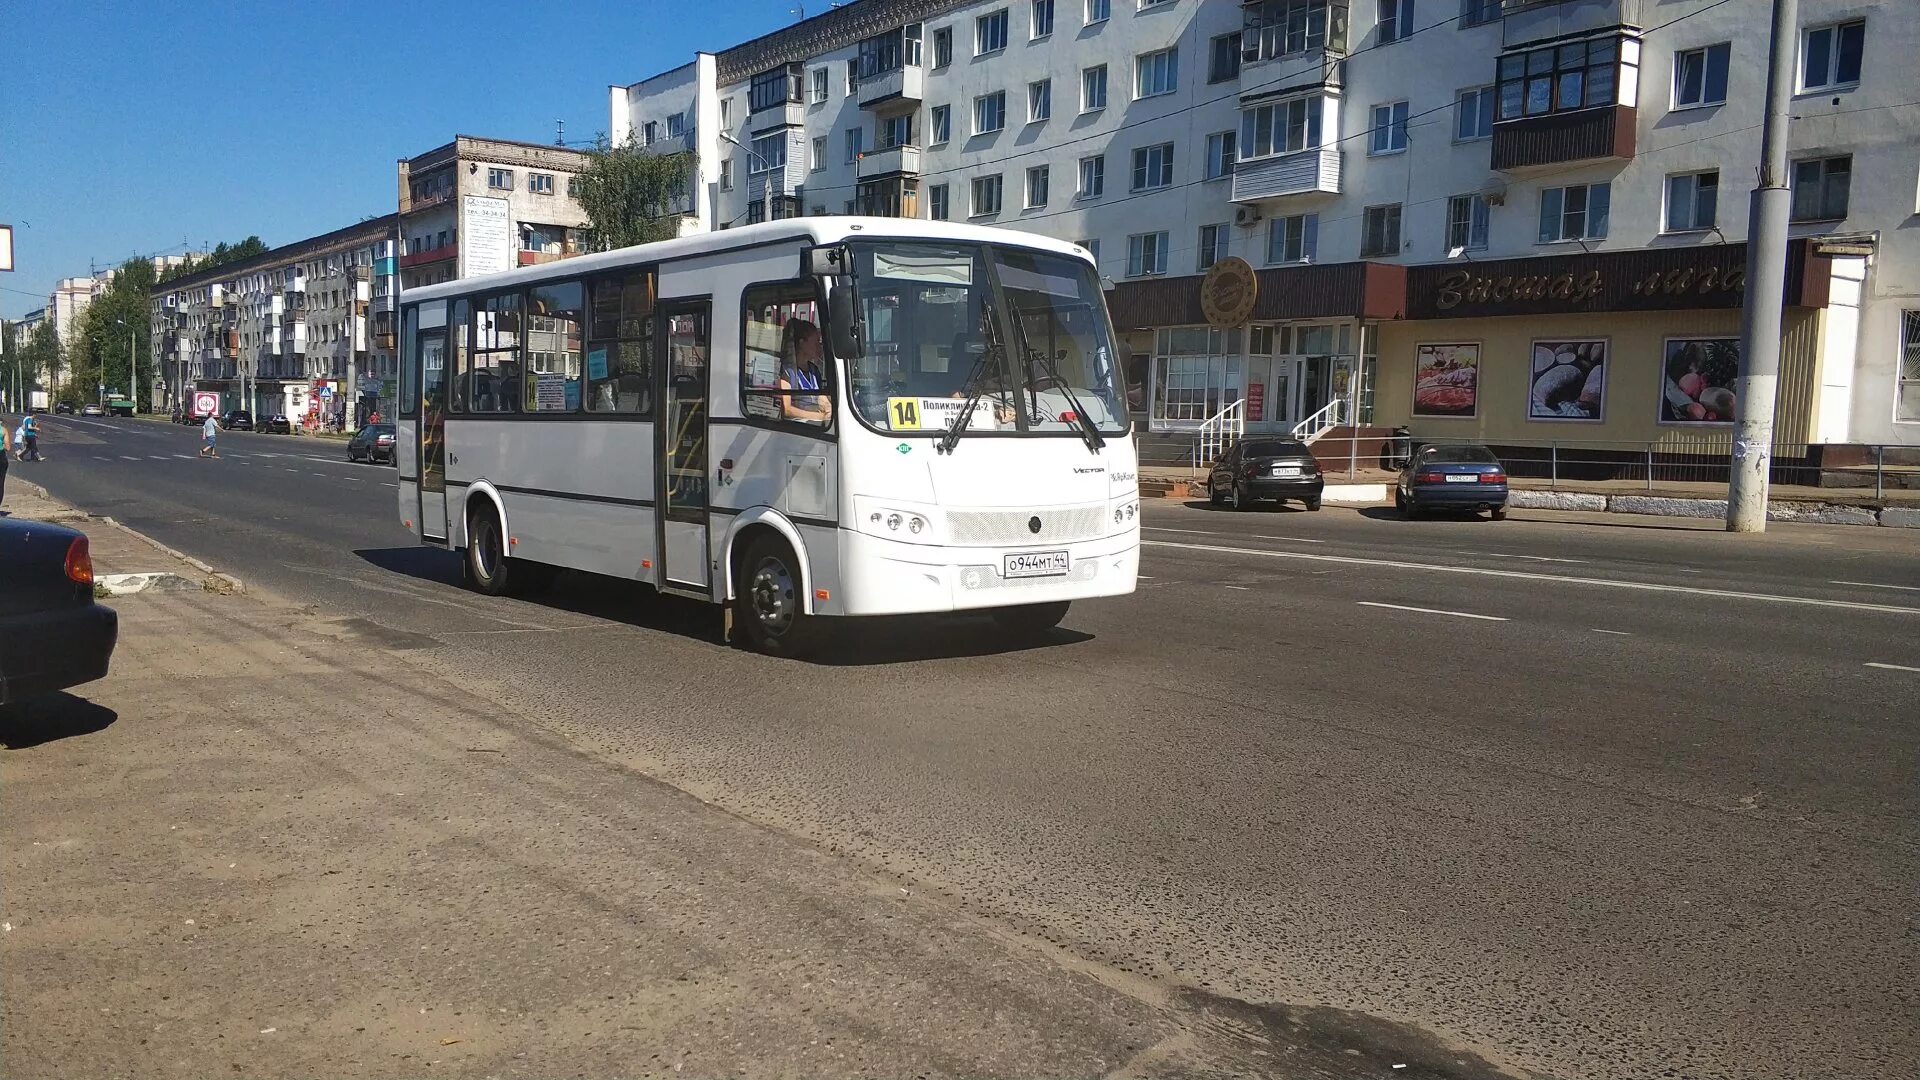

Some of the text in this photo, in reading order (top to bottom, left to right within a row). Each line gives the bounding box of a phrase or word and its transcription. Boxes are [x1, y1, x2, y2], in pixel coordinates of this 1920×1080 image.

[1436, 268, 1603, 310] Высшая
[894, 402, 917, 425] 14
[1009, 554, 1065, 571] О944МТ 44
